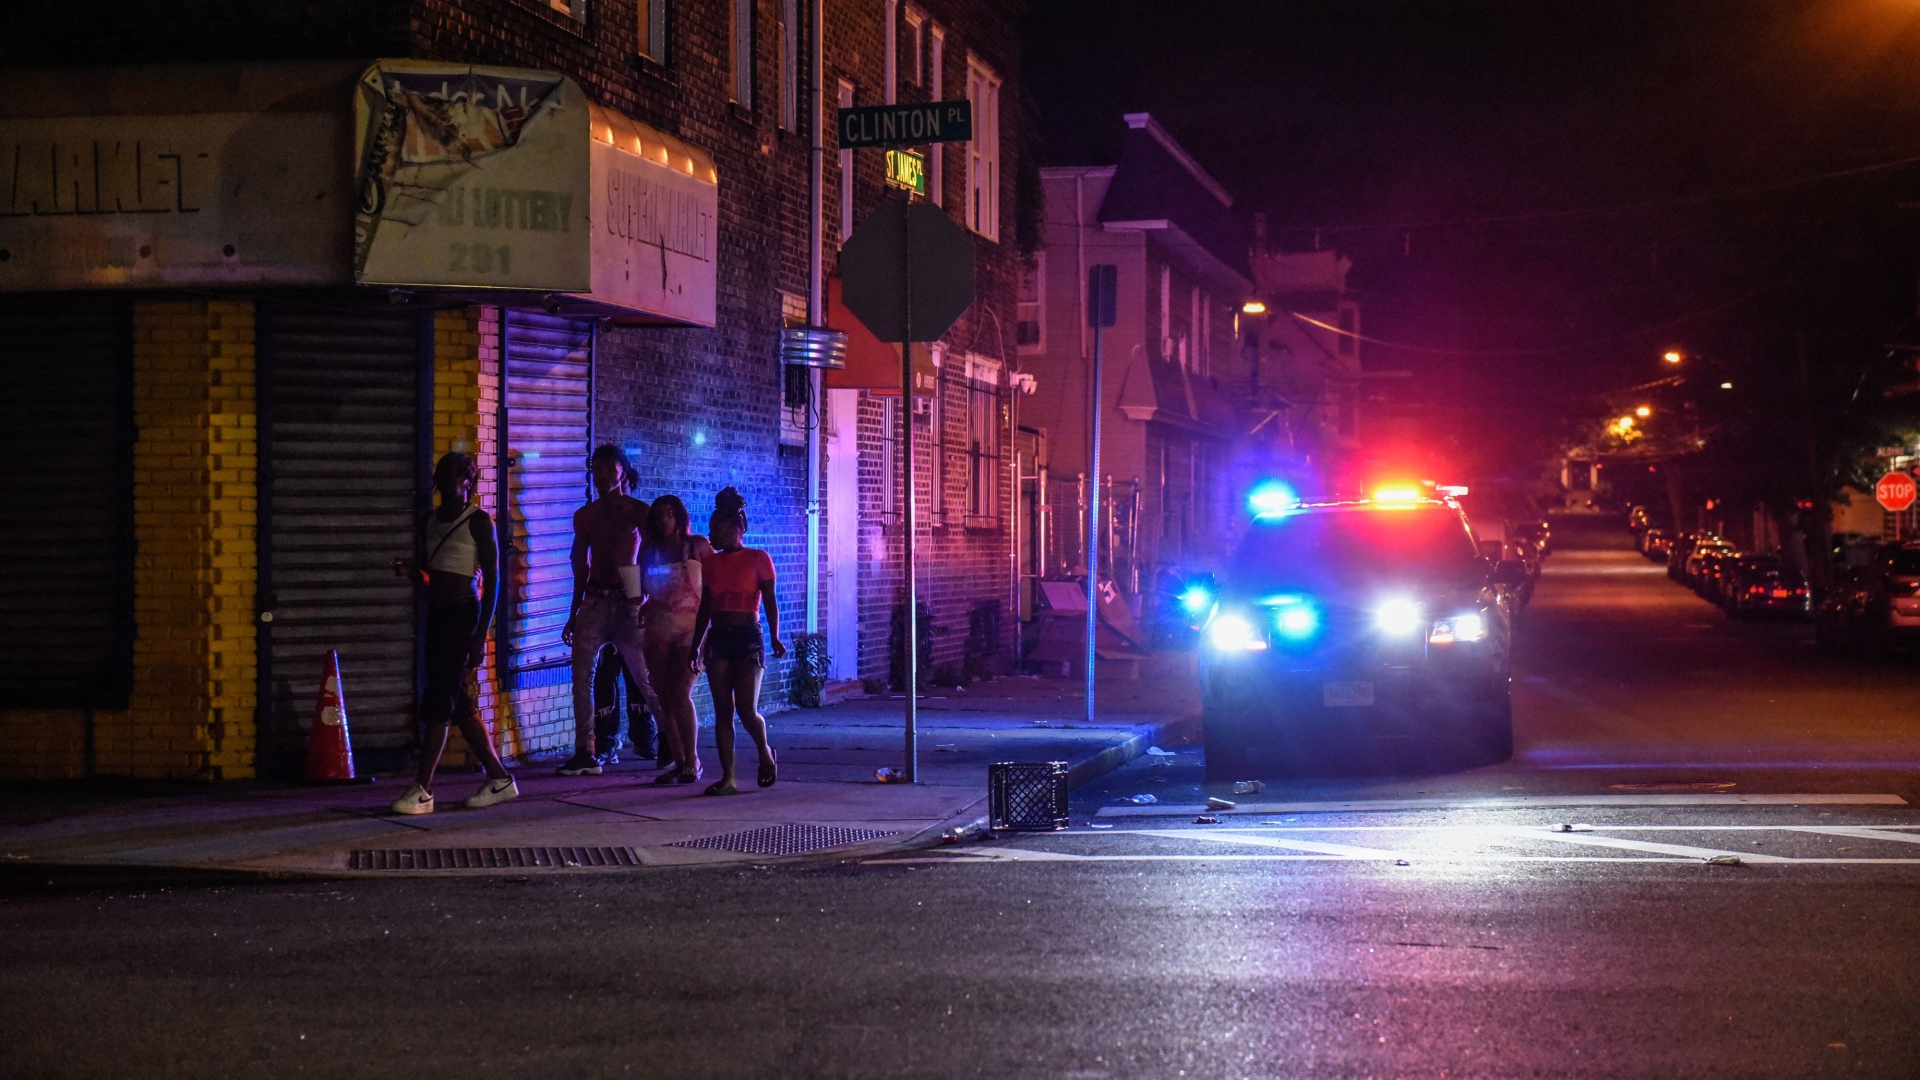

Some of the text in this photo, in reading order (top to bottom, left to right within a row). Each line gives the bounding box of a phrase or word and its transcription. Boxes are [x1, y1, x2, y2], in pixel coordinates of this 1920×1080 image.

[845, 108, 964, 142] CLINTON PL
[886, 151, 895, 179] ST
[896, 152, 917, 187] JAMES
[1879, 483, 1913, 499] STOP
